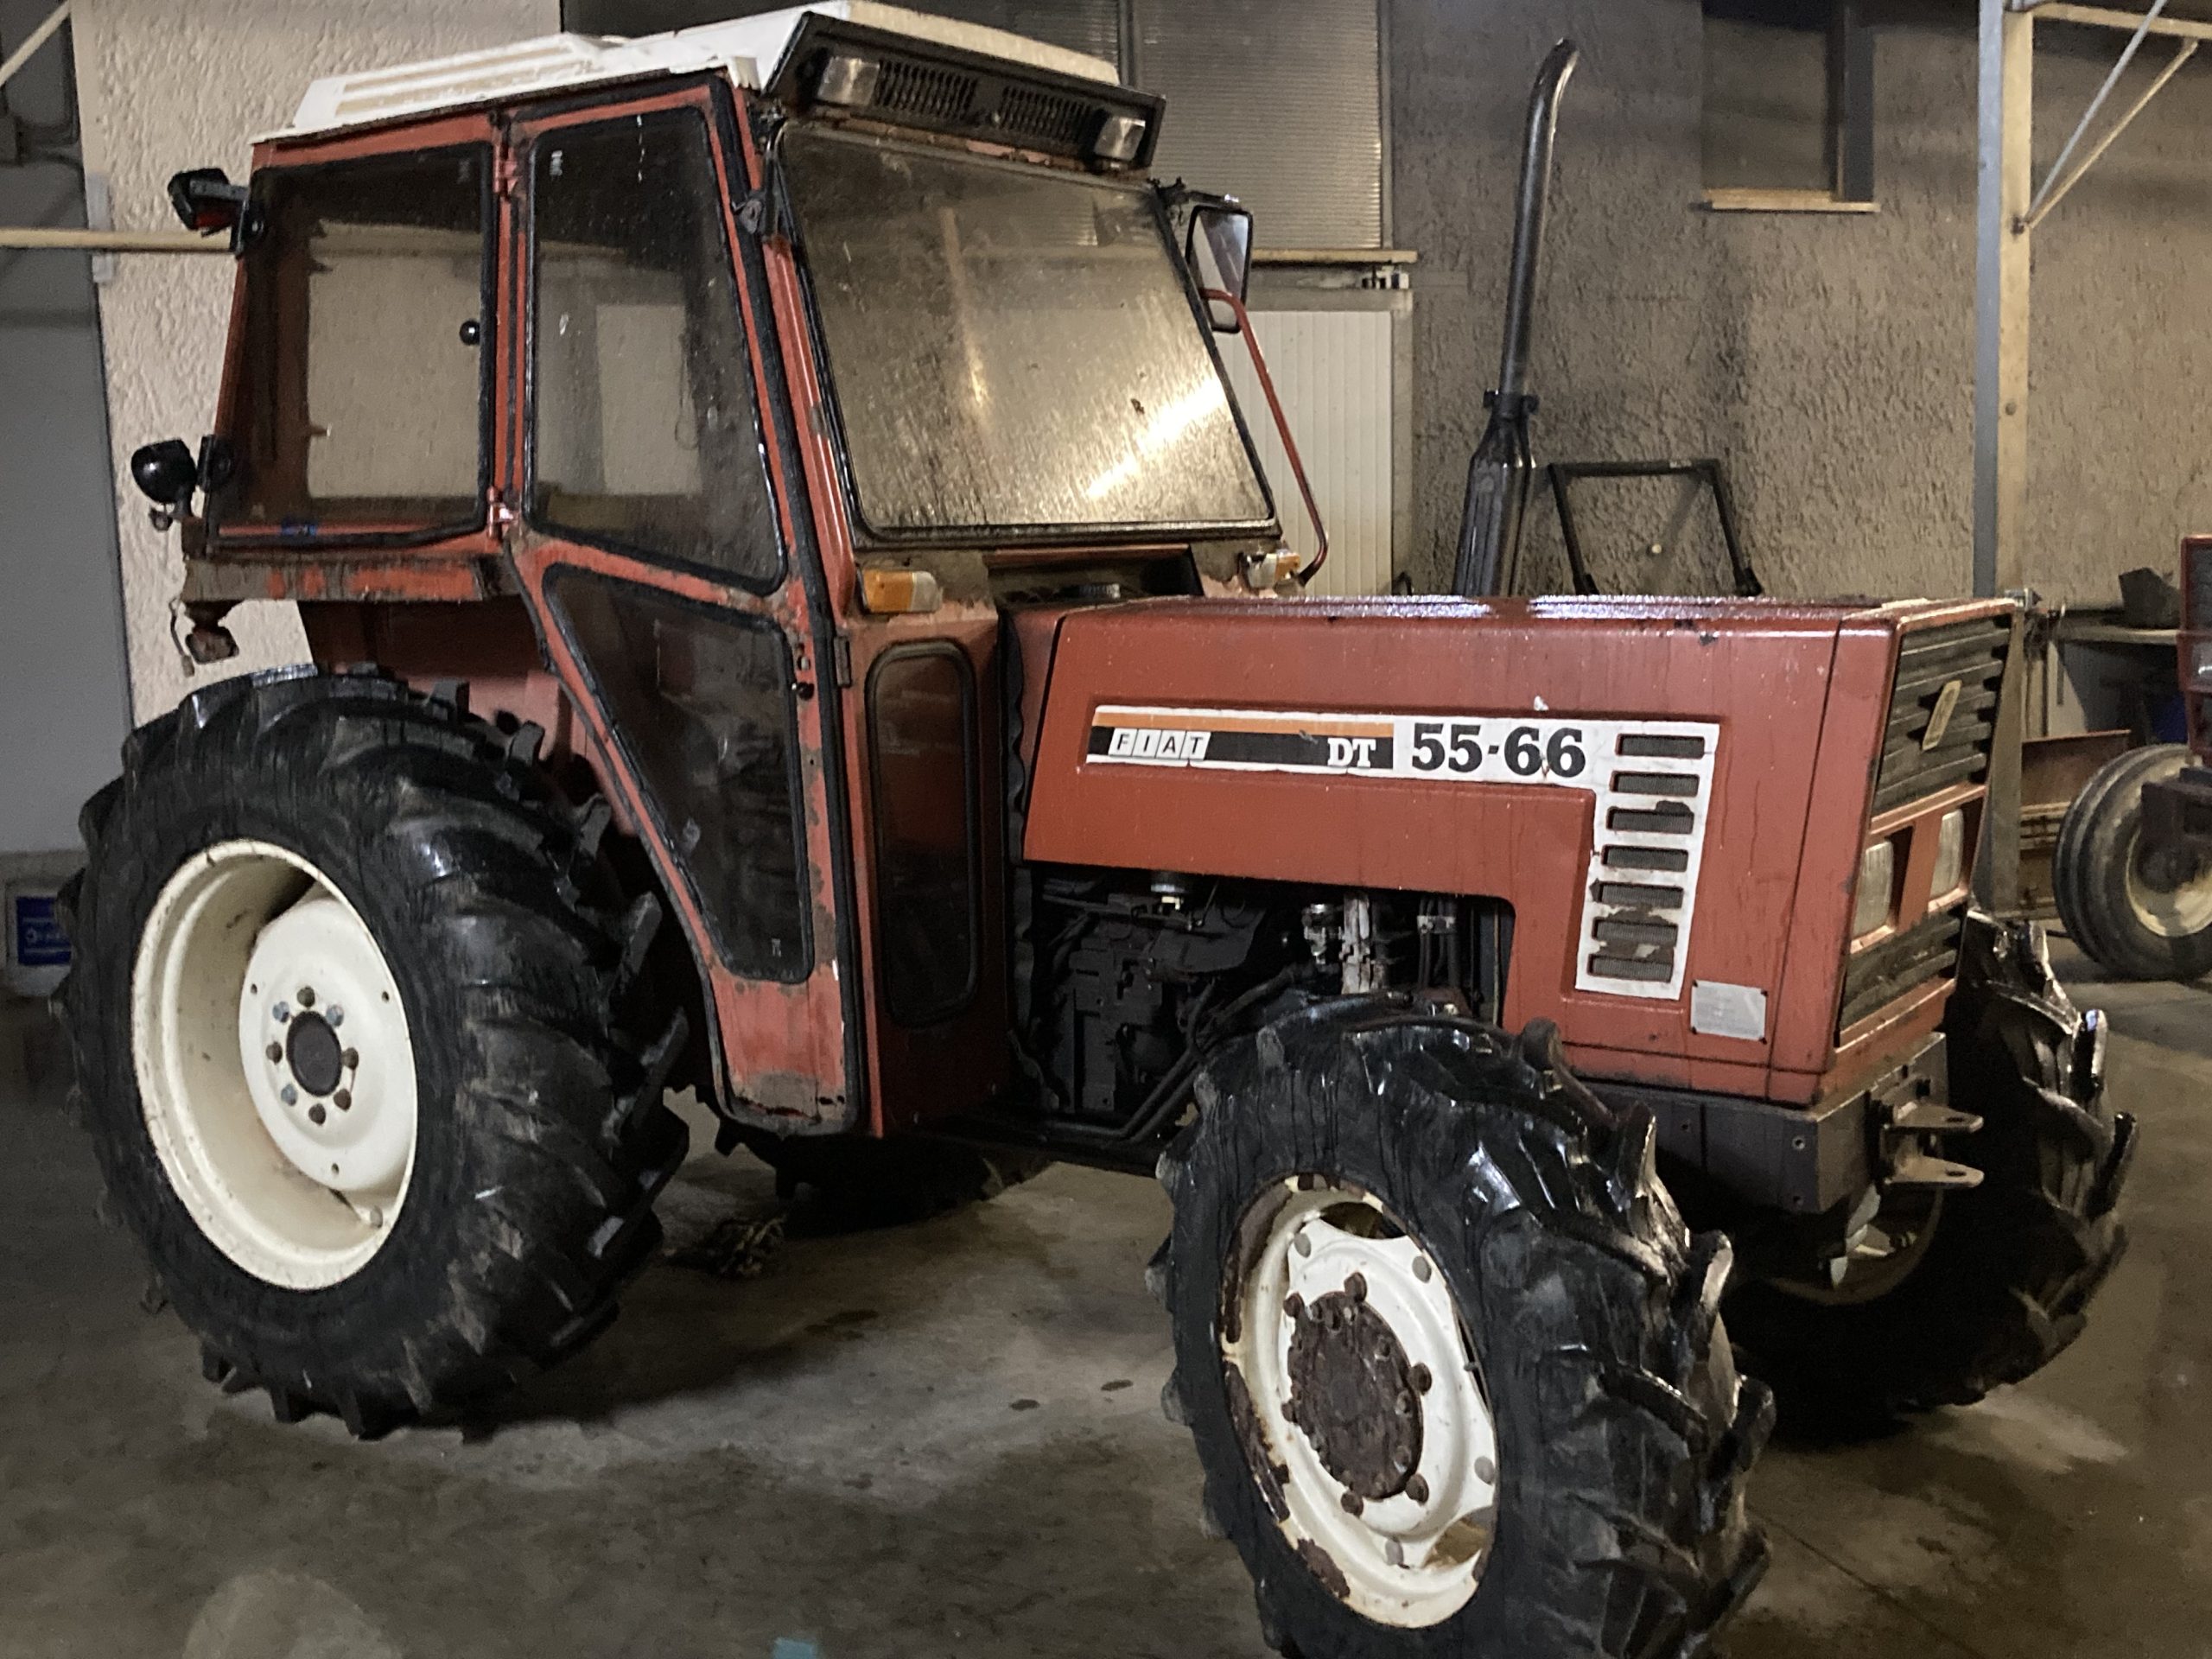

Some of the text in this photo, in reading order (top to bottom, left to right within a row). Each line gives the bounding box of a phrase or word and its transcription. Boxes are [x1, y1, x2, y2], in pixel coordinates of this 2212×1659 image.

[1114, 722, 1586, 777] FIAT DT 55-66
